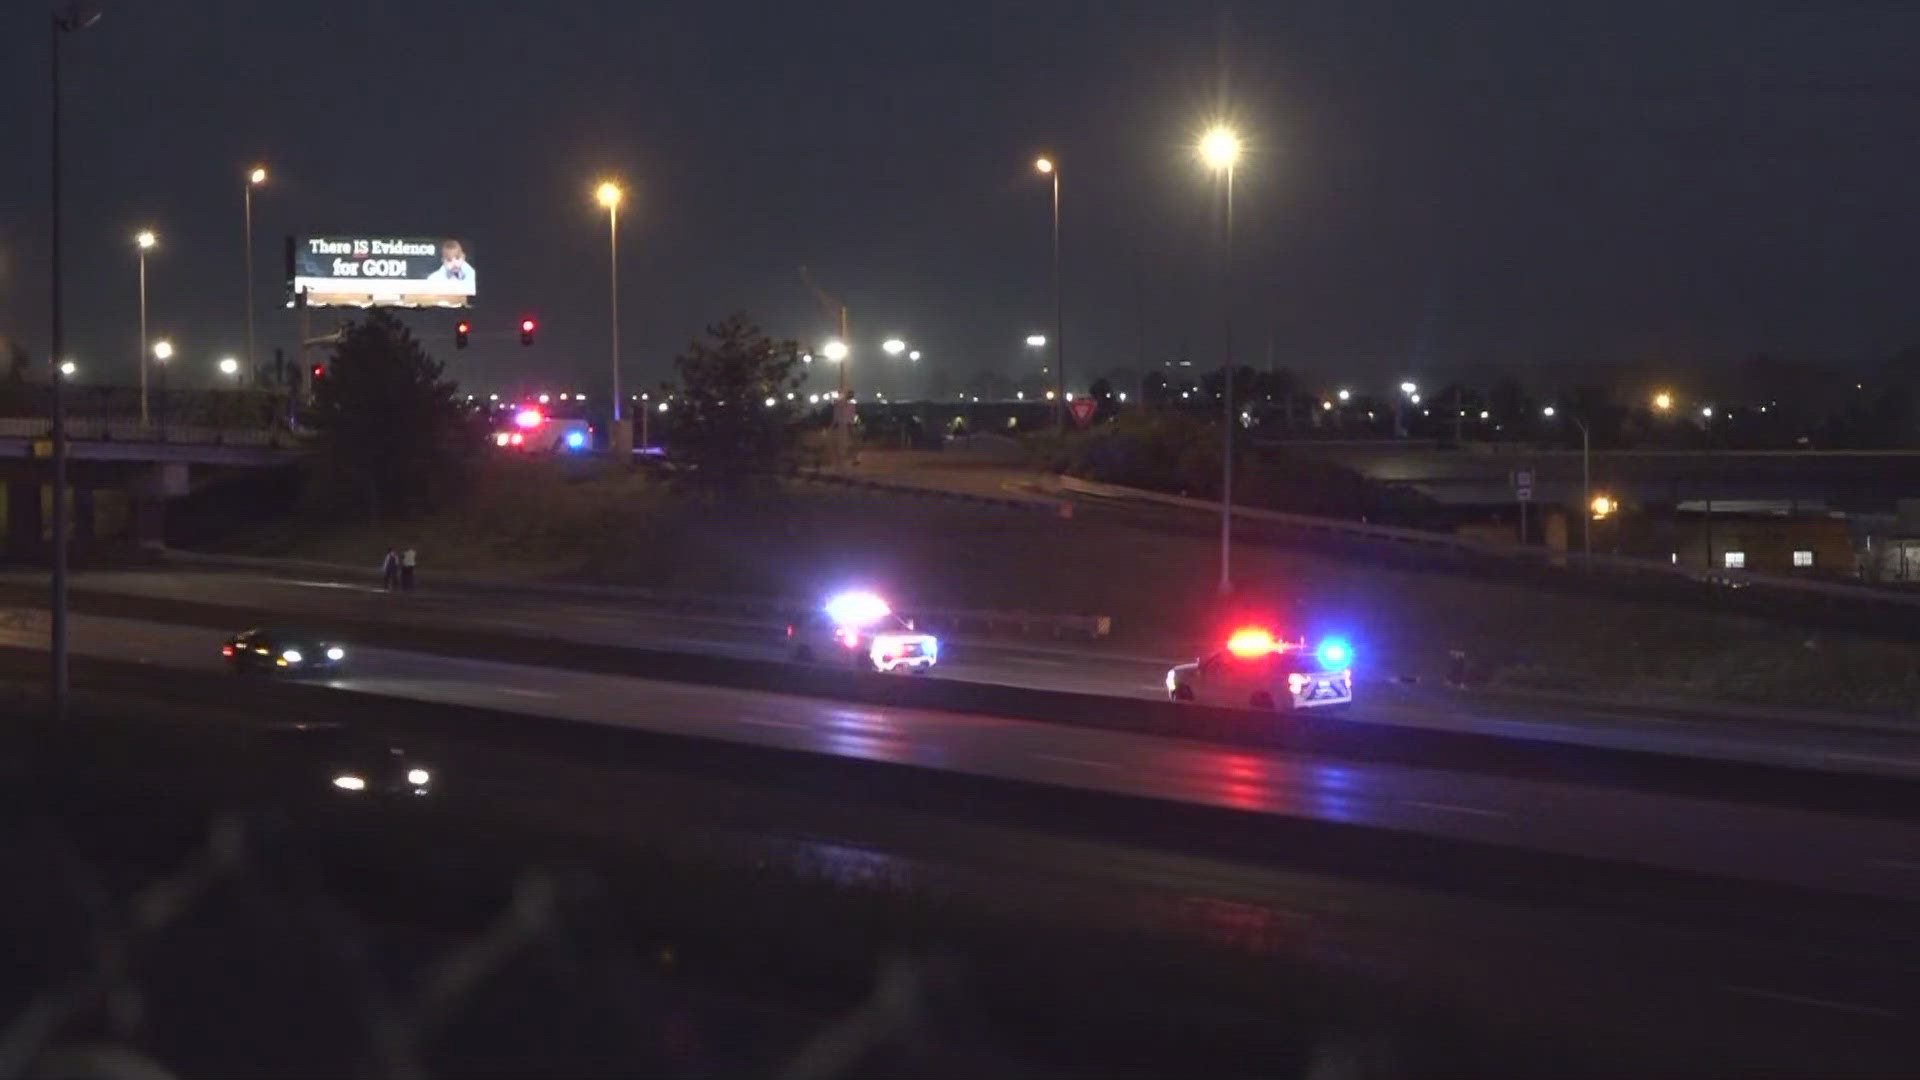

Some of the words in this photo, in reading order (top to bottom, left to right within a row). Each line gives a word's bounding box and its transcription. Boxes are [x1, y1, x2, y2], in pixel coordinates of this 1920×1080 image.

[309, 239, 351, 254] There
[353, 239, 369, 255] IS
[372, 240, 435, 256] Evidence
[332, 258, 360, 276] for
[362, 259, 407, 276] GOD!
